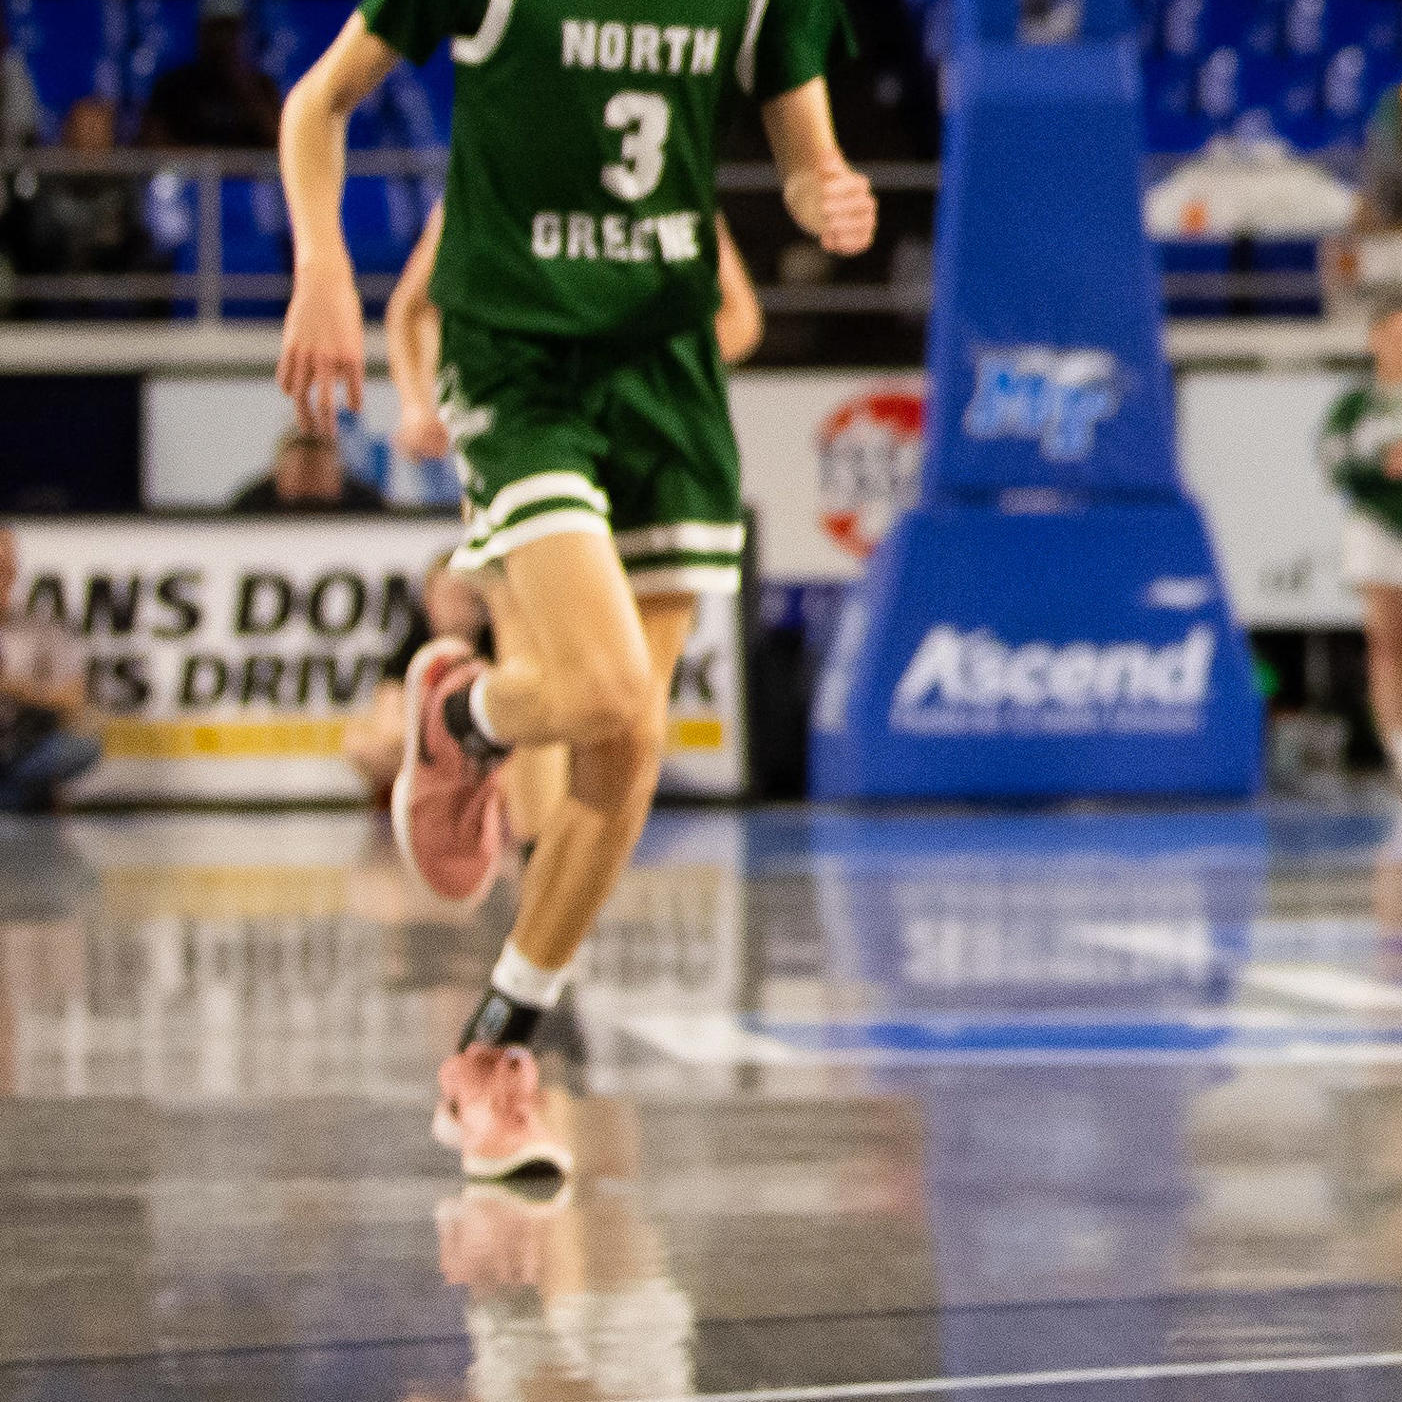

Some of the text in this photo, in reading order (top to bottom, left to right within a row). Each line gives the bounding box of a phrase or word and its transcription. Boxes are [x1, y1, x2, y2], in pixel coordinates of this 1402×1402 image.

[560, 18, 721, 76] NORTH
[601, 90, 672, 202] 3
[25, 568, 202, 640] ANS
[889, 622, 1217, 704] Ascend
